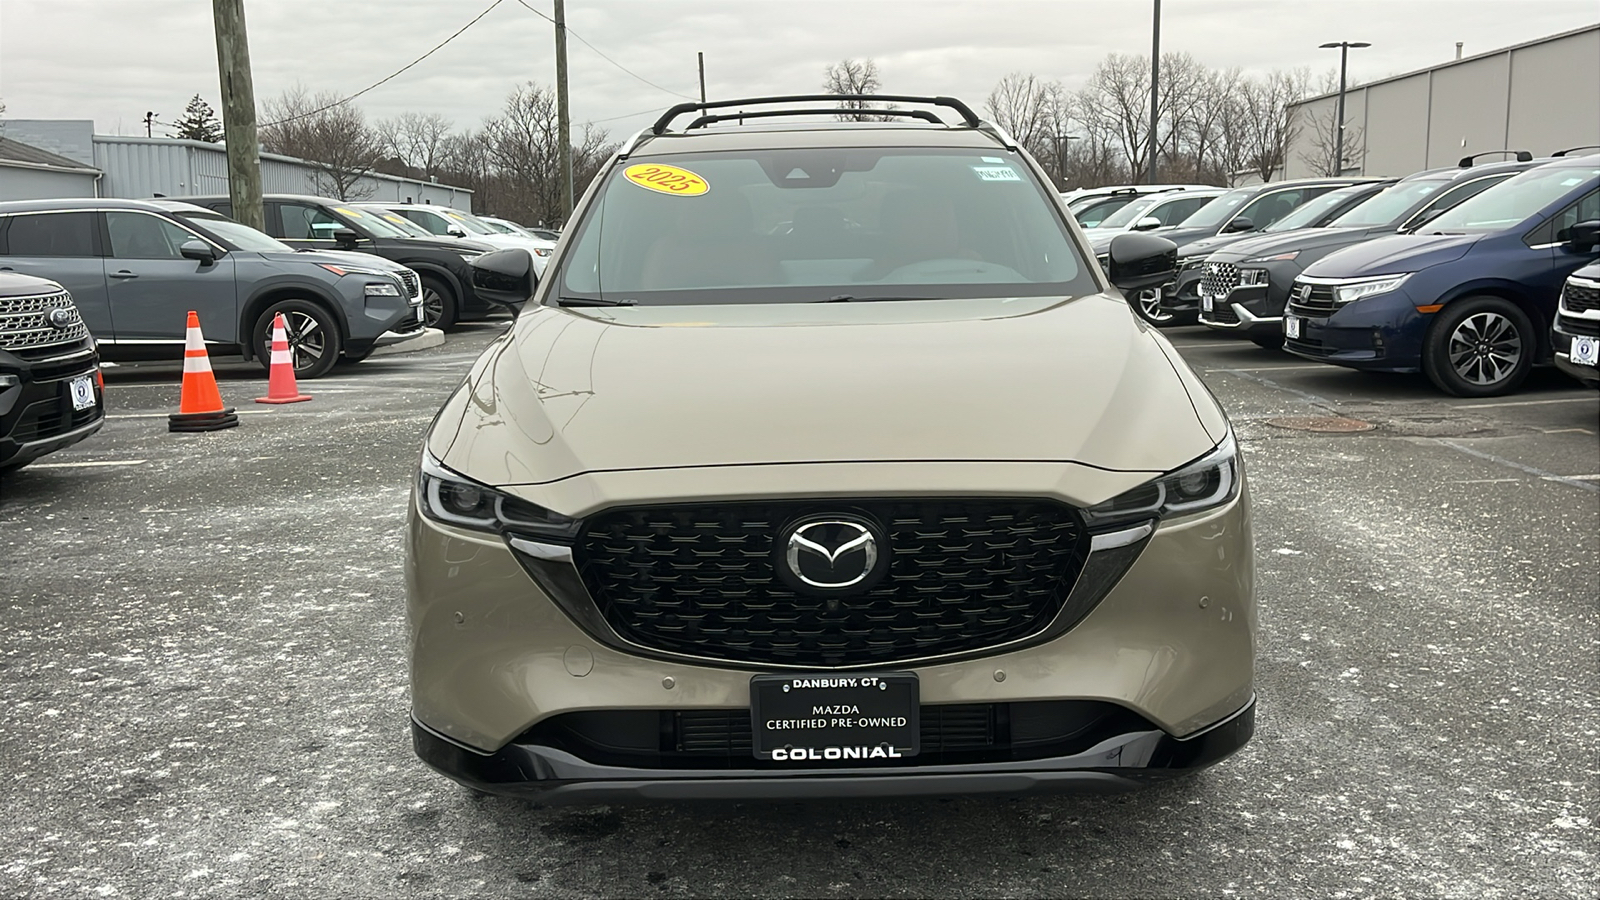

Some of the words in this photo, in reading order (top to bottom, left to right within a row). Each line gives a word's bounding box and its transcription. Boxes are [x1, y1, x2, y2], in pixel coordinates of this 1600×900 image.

[632, 168, 700, 191] 2025
[793, 678, 858, 688] DANBURY,
[861, 678, 879, 687] CT
[812, 705, 860, 715] MAZDA
[766, 719, 827, 730] CERTIFIED
[831, 717, 907, 728] PRE-OWNED
[772, 746, 902, 761] COLONIAL
